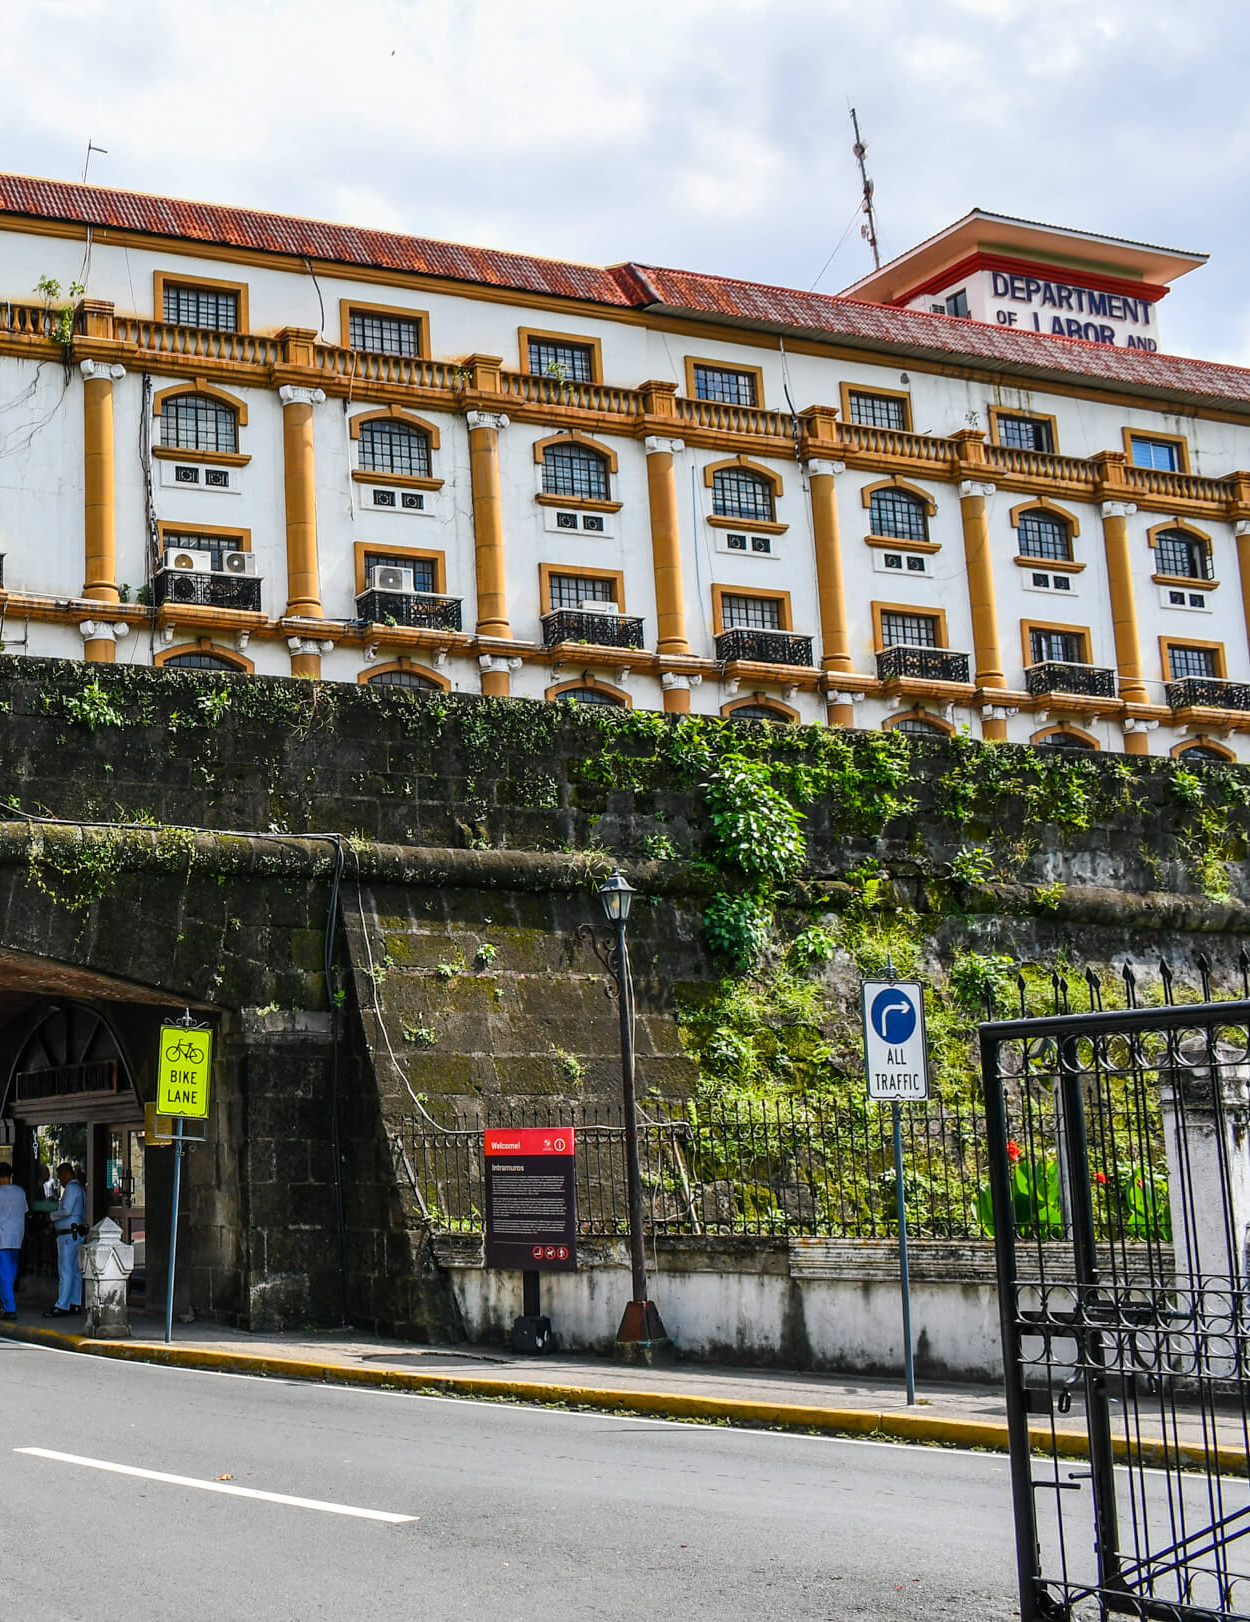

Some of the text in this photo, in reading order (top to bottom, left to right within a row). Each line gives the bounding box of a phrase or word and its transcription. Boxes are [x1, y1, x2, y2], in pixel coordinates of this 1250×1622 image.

[991, 271, 1153, 326] DEPARTMENT
[996, 310, 1018, 326] OF
[1127, 334, 1158, 353] AND
[887, 1047, 907, 1065] ALL
[170, 1069, 198, 1085] BIKE
[874, 1073, 920, 1091] TRAFFIC
[167, 1088, 198, 1105] LANE
[491, 1141, 521, 1150] Welcome!
[491, 1163, 525, 1172] Intramuros
